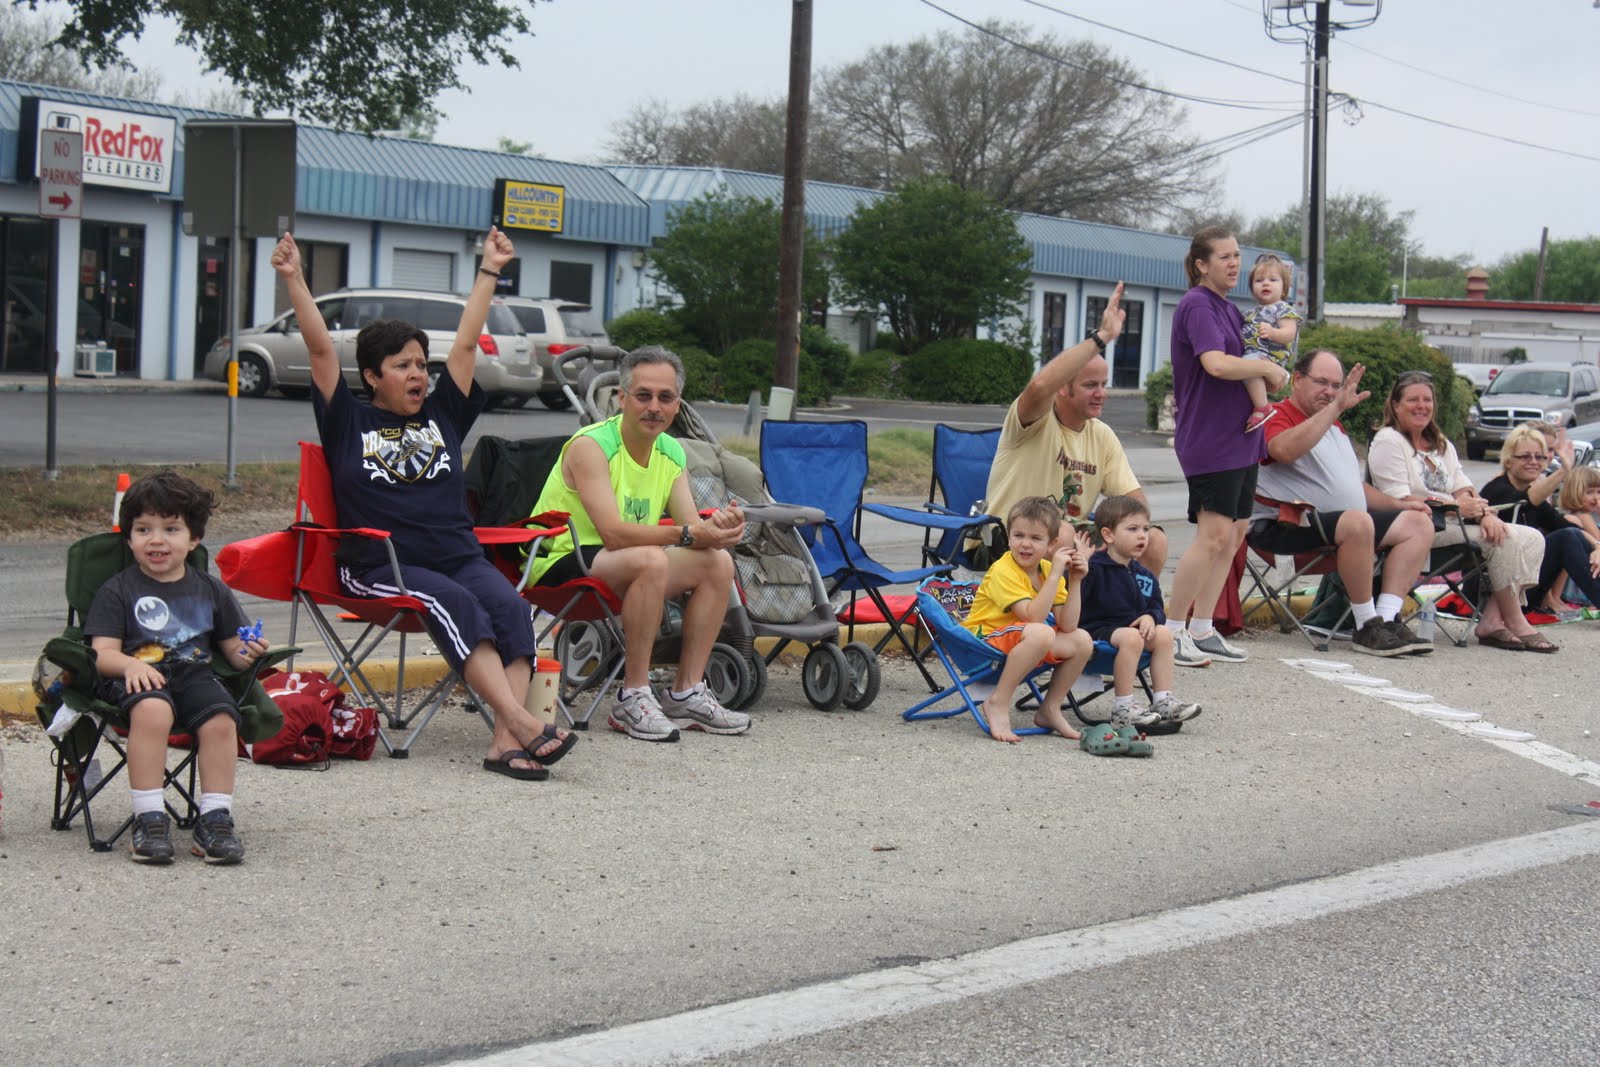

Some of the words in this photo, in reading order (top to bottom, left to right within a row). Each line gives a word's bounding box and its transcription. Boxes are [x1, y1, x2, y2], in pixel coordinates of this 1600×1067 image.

[53, 141, 70, 158] NO
[41, 167, 81, 186] PARKING
[86, 158, 161, 181] CLEANERS
